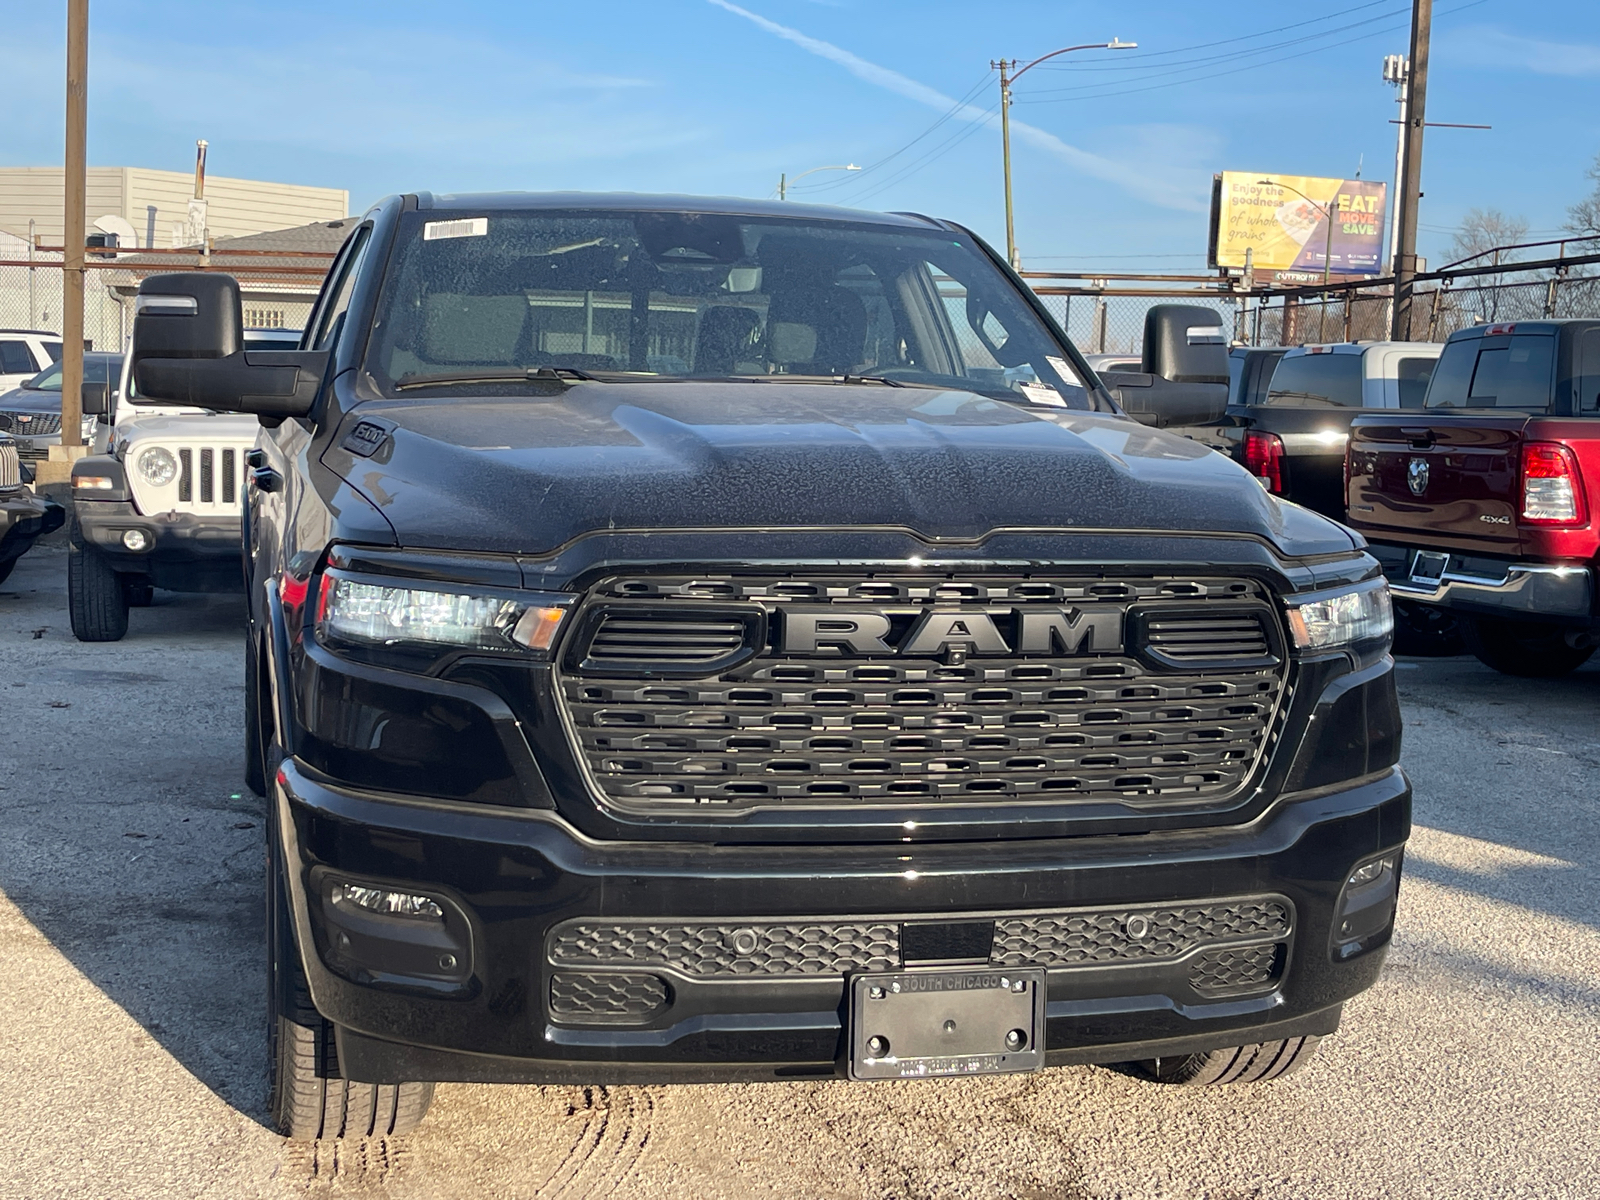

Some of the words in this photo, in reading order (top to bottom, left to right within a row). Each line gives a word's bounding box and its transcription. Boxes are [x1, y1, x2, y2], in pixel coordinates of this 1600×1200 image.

[1232, 183, 1263, 196] Enjoy
[1265, 185, 1285, 196] the
[1232, 196, 1285, 208] goodness
[1338, 194, 1379, 214] EAT.
[1229, 210, 1246, 226] of
[1246, 212, 1279, 227] whole
[1339, 211, 1379, 224] MOVE.
[1227, 229, 1266, 243] grains
[1342, 223, 1378, 236] SAVE.
[776, 606, 1125, 654] RAM
[903, 977, 943, 992] SOUTH
[947, 975, 998, 990] CHICAGO
